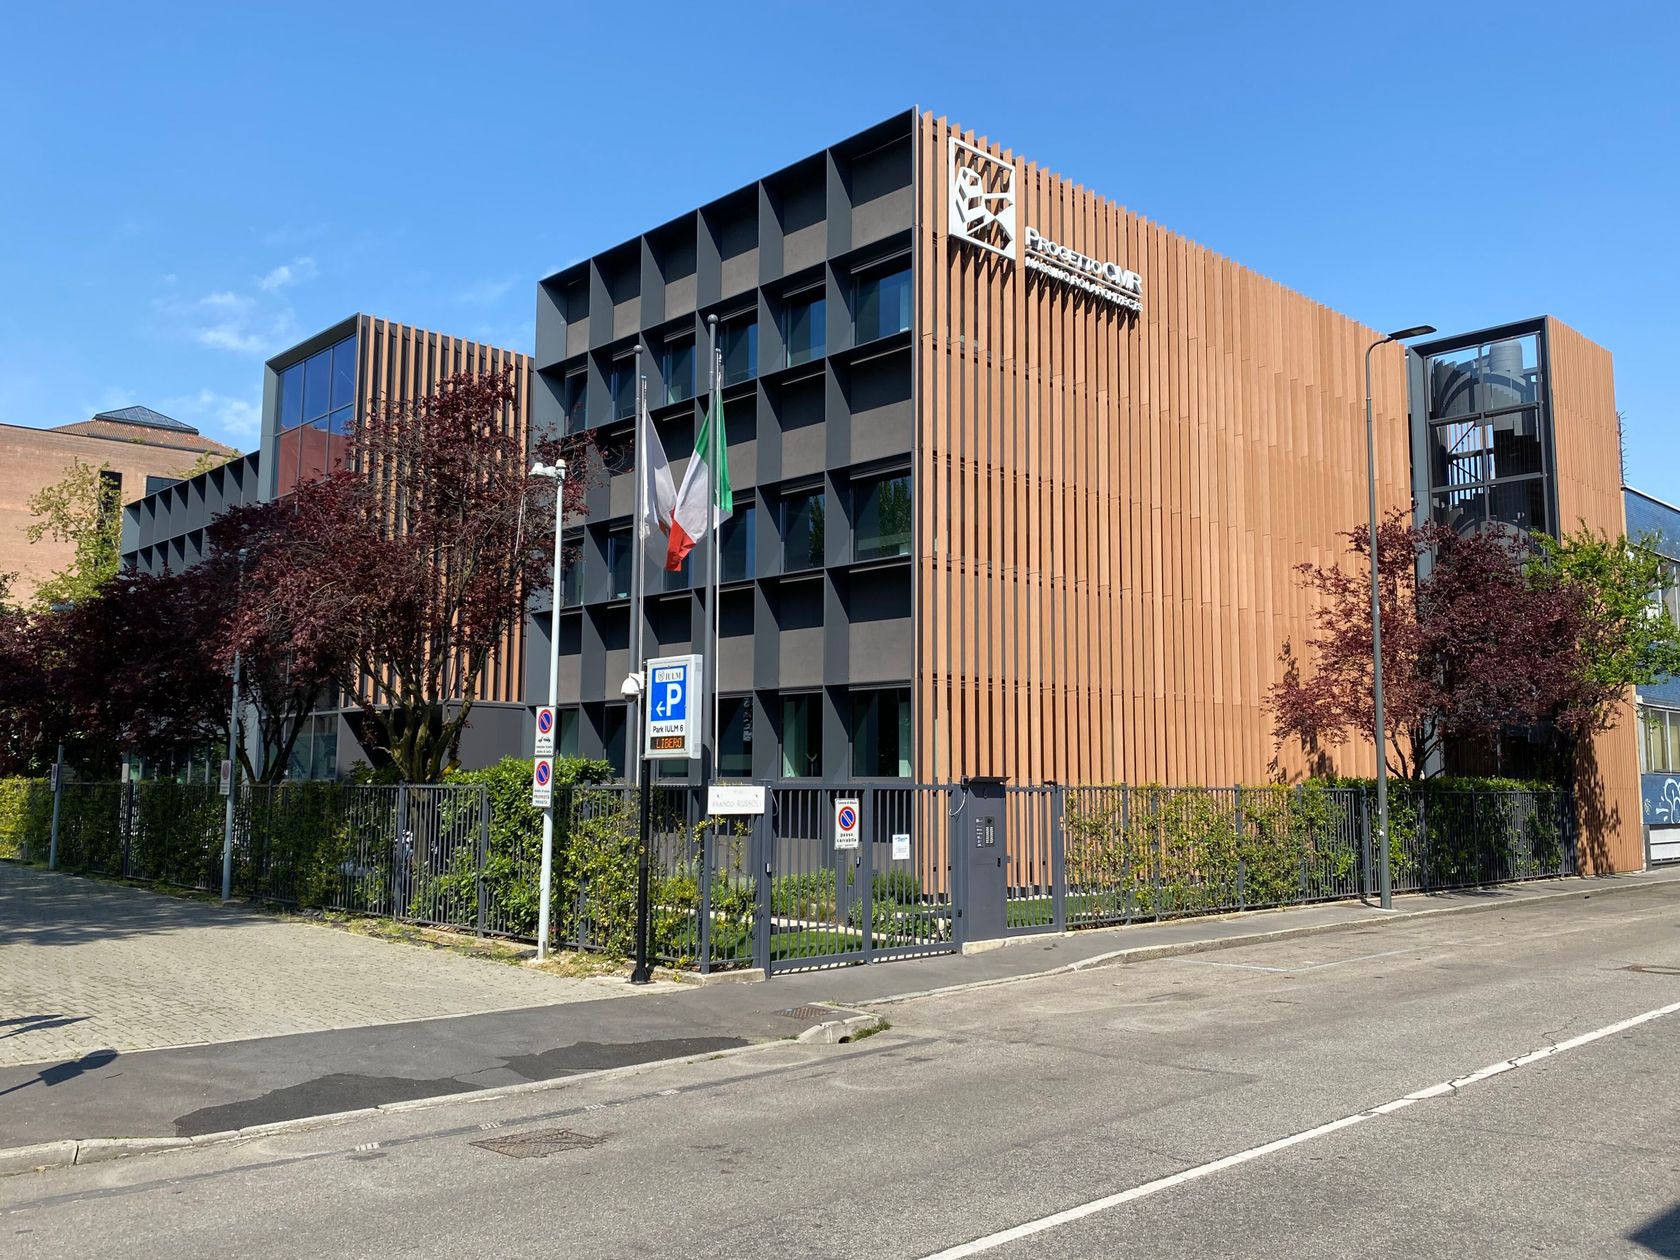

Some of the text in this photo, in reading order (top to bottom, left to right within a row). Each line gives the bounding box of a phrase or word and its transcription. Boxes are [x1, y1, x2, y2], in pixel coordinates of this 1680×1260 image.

[665, 671, 681, 681] IULM
[666, 682, 682, 717] P
[653, 724, 684, 734] Park IULM 6
[656, 738, 682, 749] LIBERO
